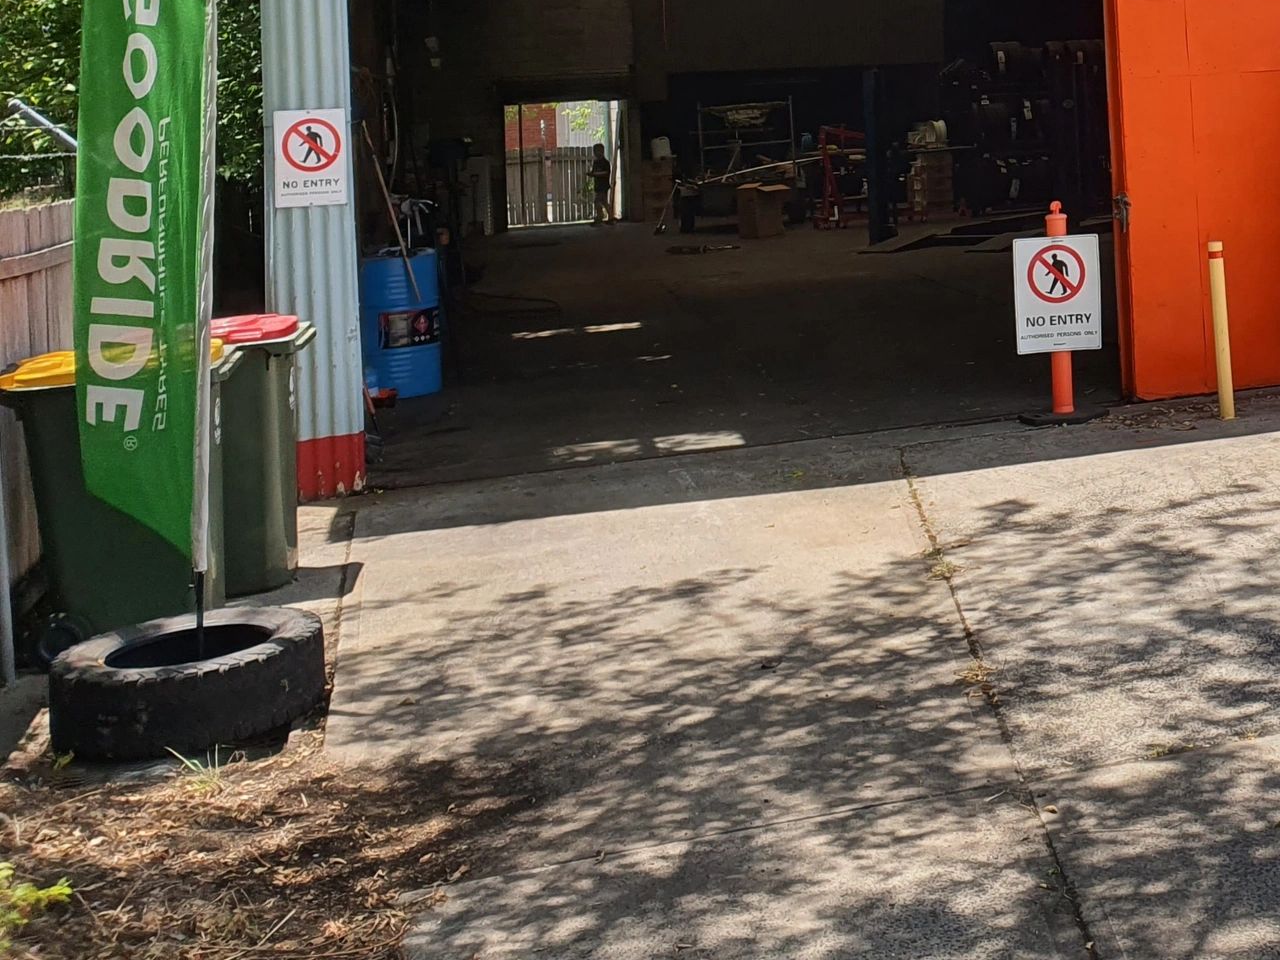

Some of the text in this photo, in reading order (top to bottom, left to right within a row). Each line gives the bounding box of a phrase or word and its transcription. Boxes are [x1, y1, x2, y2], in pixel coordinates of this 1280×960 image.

[283, 178, 340, 189] NO ENTRY
[1026, 313, 1092, 327] NO ENTRY
